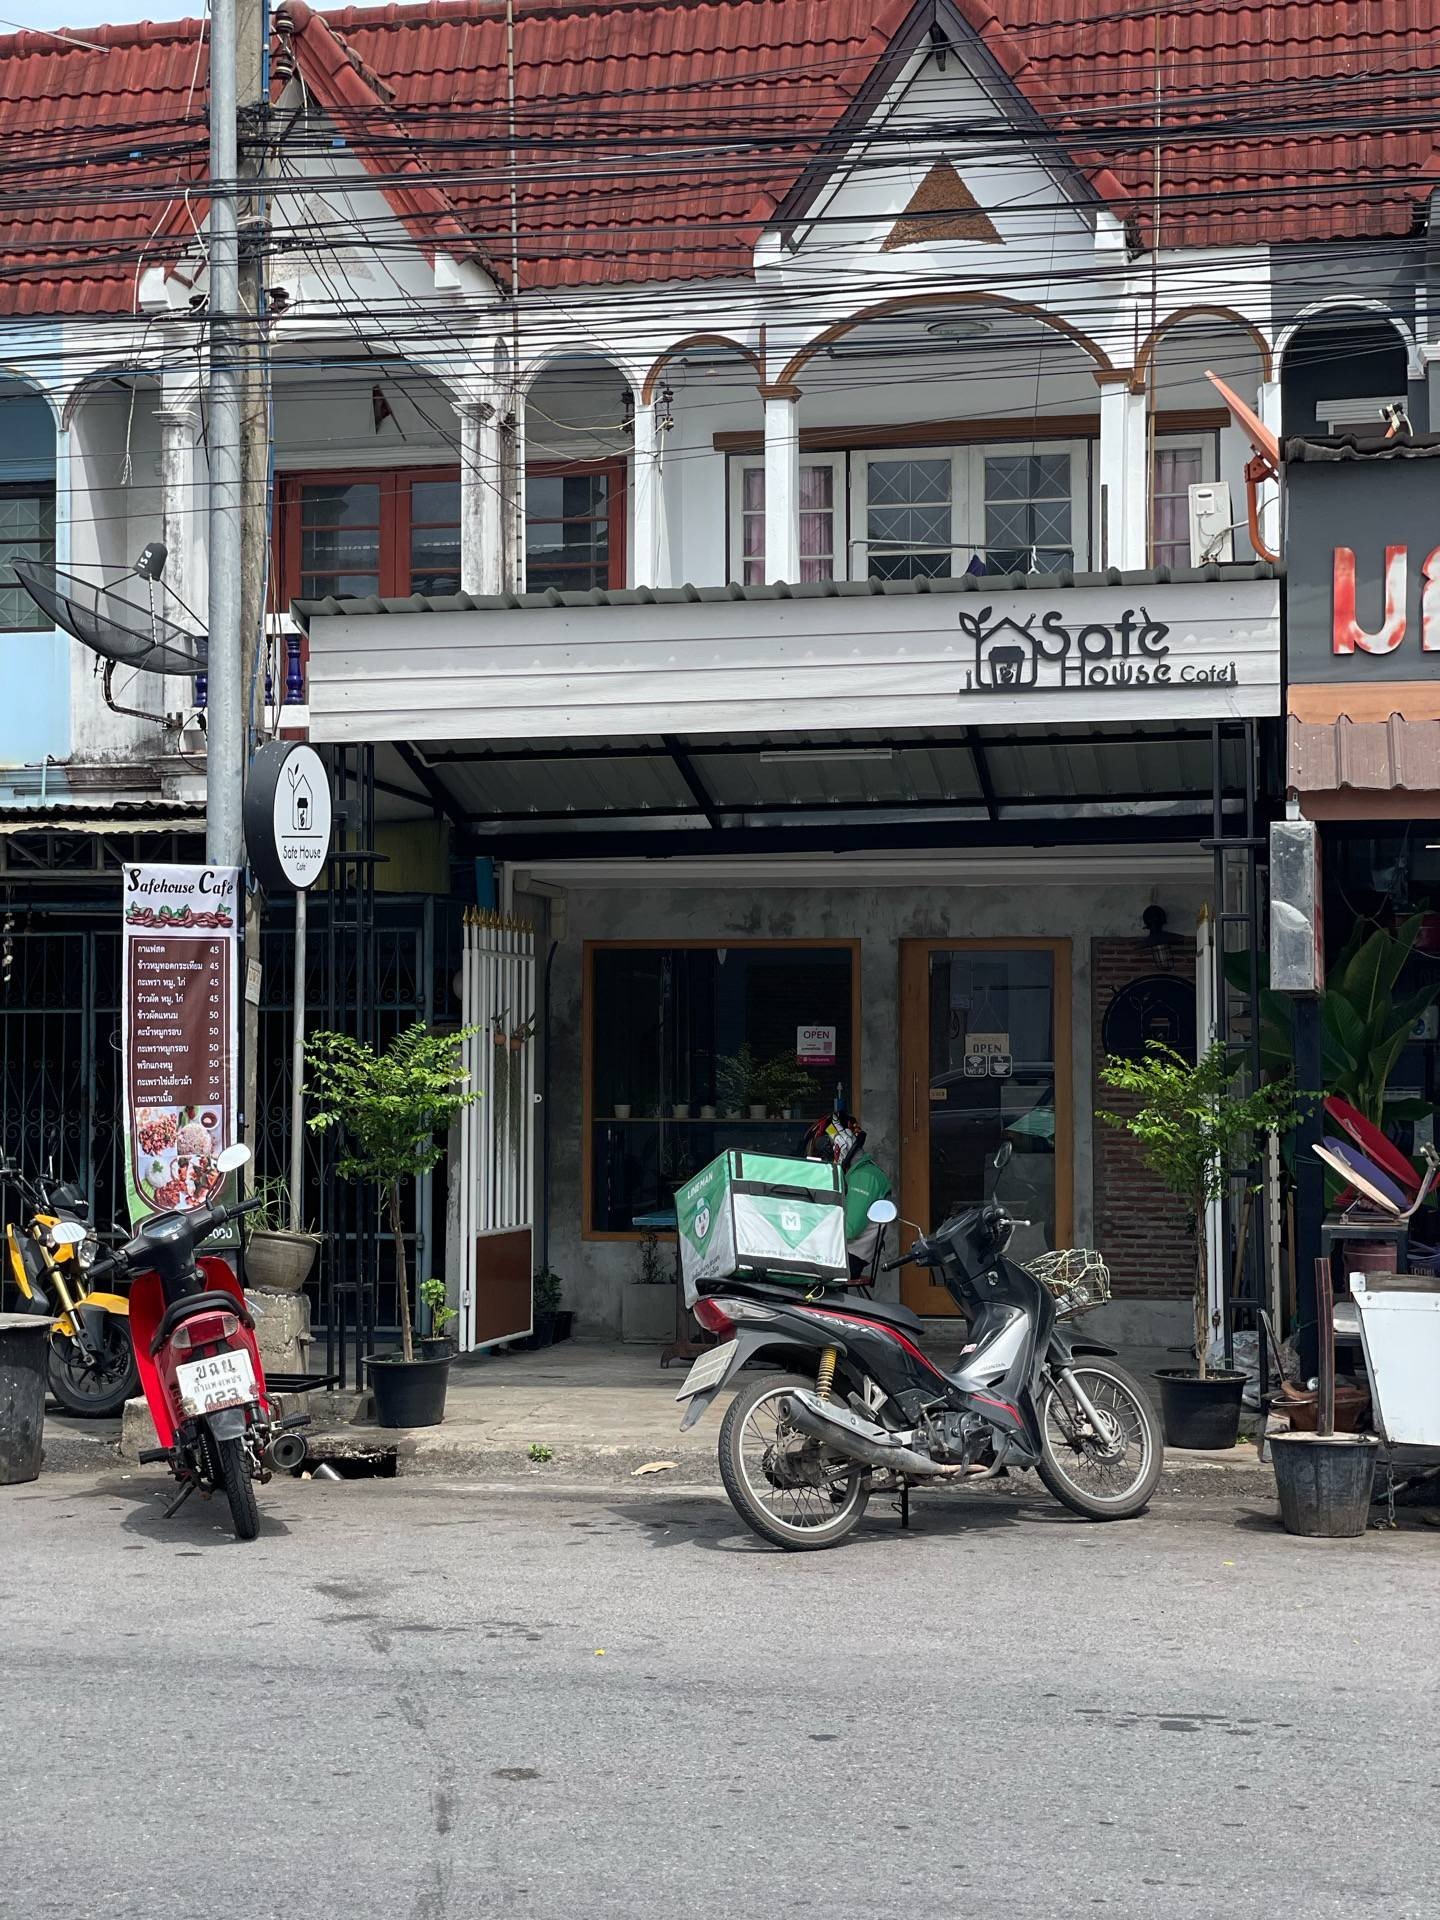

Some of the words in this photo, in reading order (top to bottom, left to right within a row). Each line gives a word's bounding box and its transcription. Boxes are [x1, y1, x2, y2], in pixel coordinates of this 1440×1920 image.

[138, 550, 153, 569] PSI
[1061, 656, 1172, 686] House
[283, 846, 297, 859] Safe
[299, 845, 321, 858] House
[127, 868, 195, 894] Safehouse
[209, 946, 219, 954] 45
[209, 962, 219, 970] 45
[209, 994, 219, 1003] 45
[209, 1011, 219, 1019] 50
[209, 1027, 219, 1036] 50
[803, 1030, 830, 1039] OPEN
[209, 1043, 219, 1051] 50
[973, 1043, 1002, 1053] OPEN
[209, 1060, 219, 1068] 50
[209, 1076, 219, 1084] 55
[209, 1092, 220, 1100] 60
